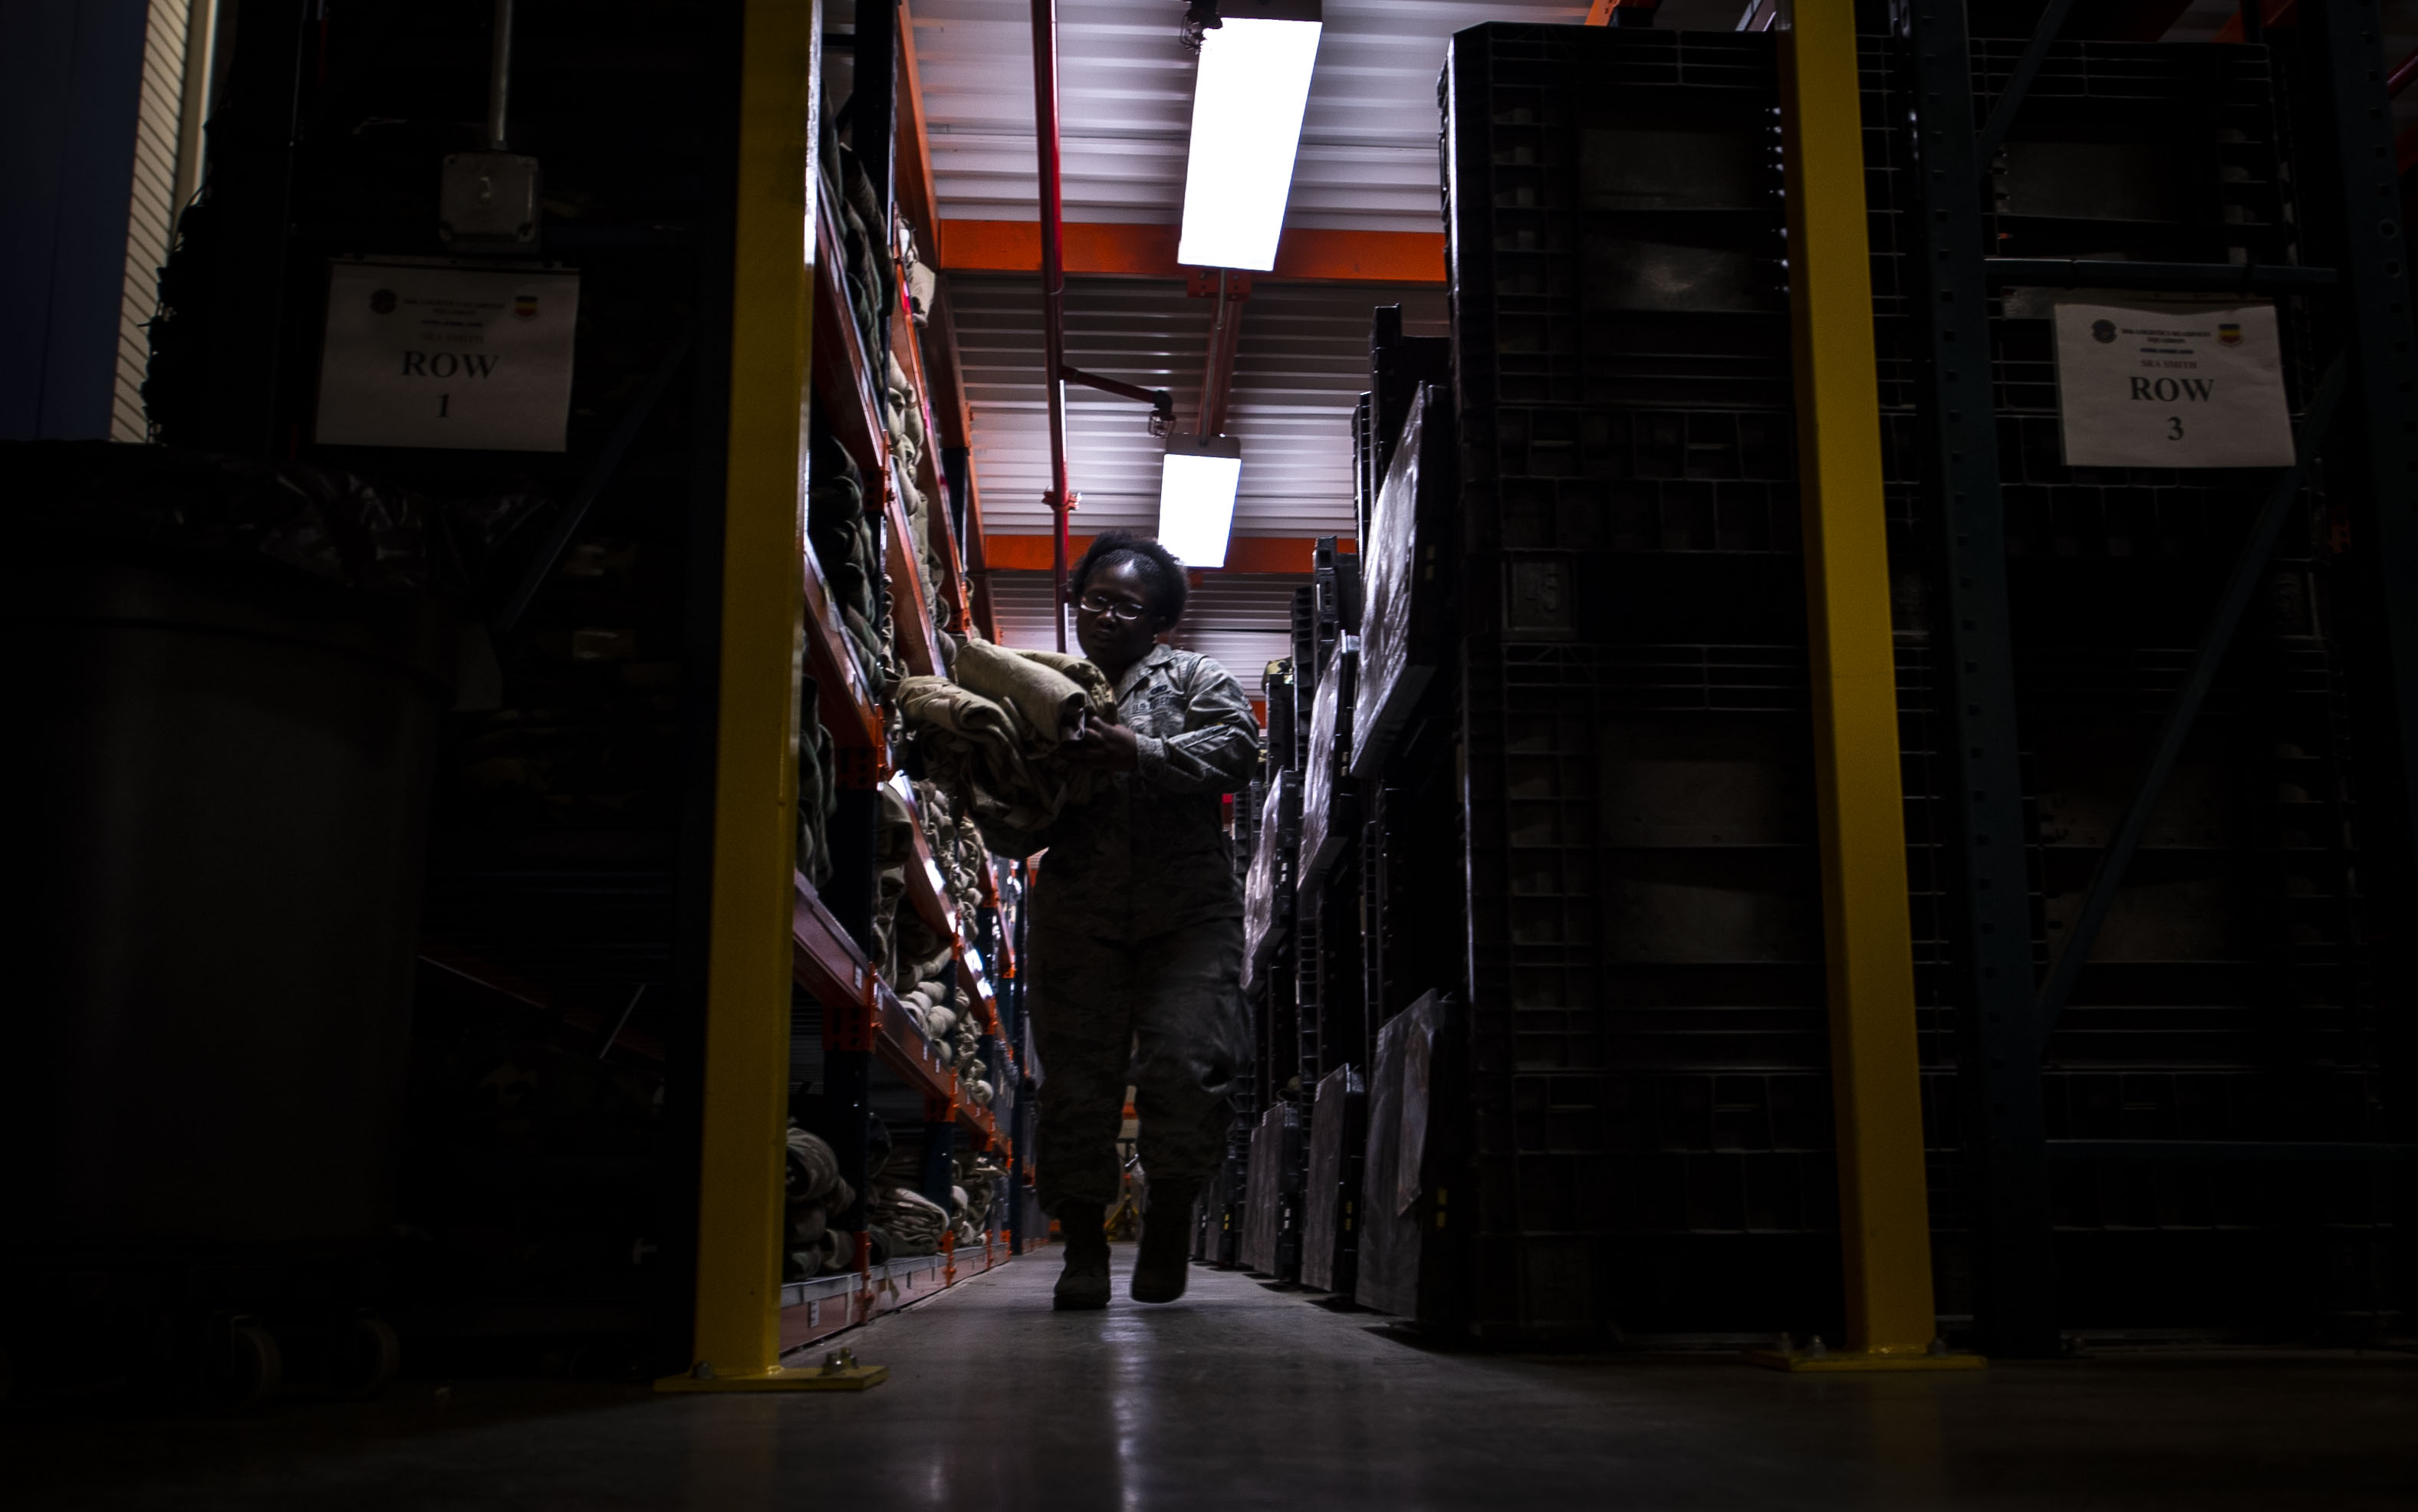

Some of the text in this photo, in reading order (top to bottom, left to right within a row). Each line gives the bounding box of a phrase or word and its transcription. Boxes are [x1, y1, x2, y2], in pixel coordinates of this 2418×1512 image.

[403, 351, 499, 379] ROW
[2130, 376, 2215, 402] ROW
[437, 393, 449, 418] 1
[2166, 416, 2184, 441] 3
